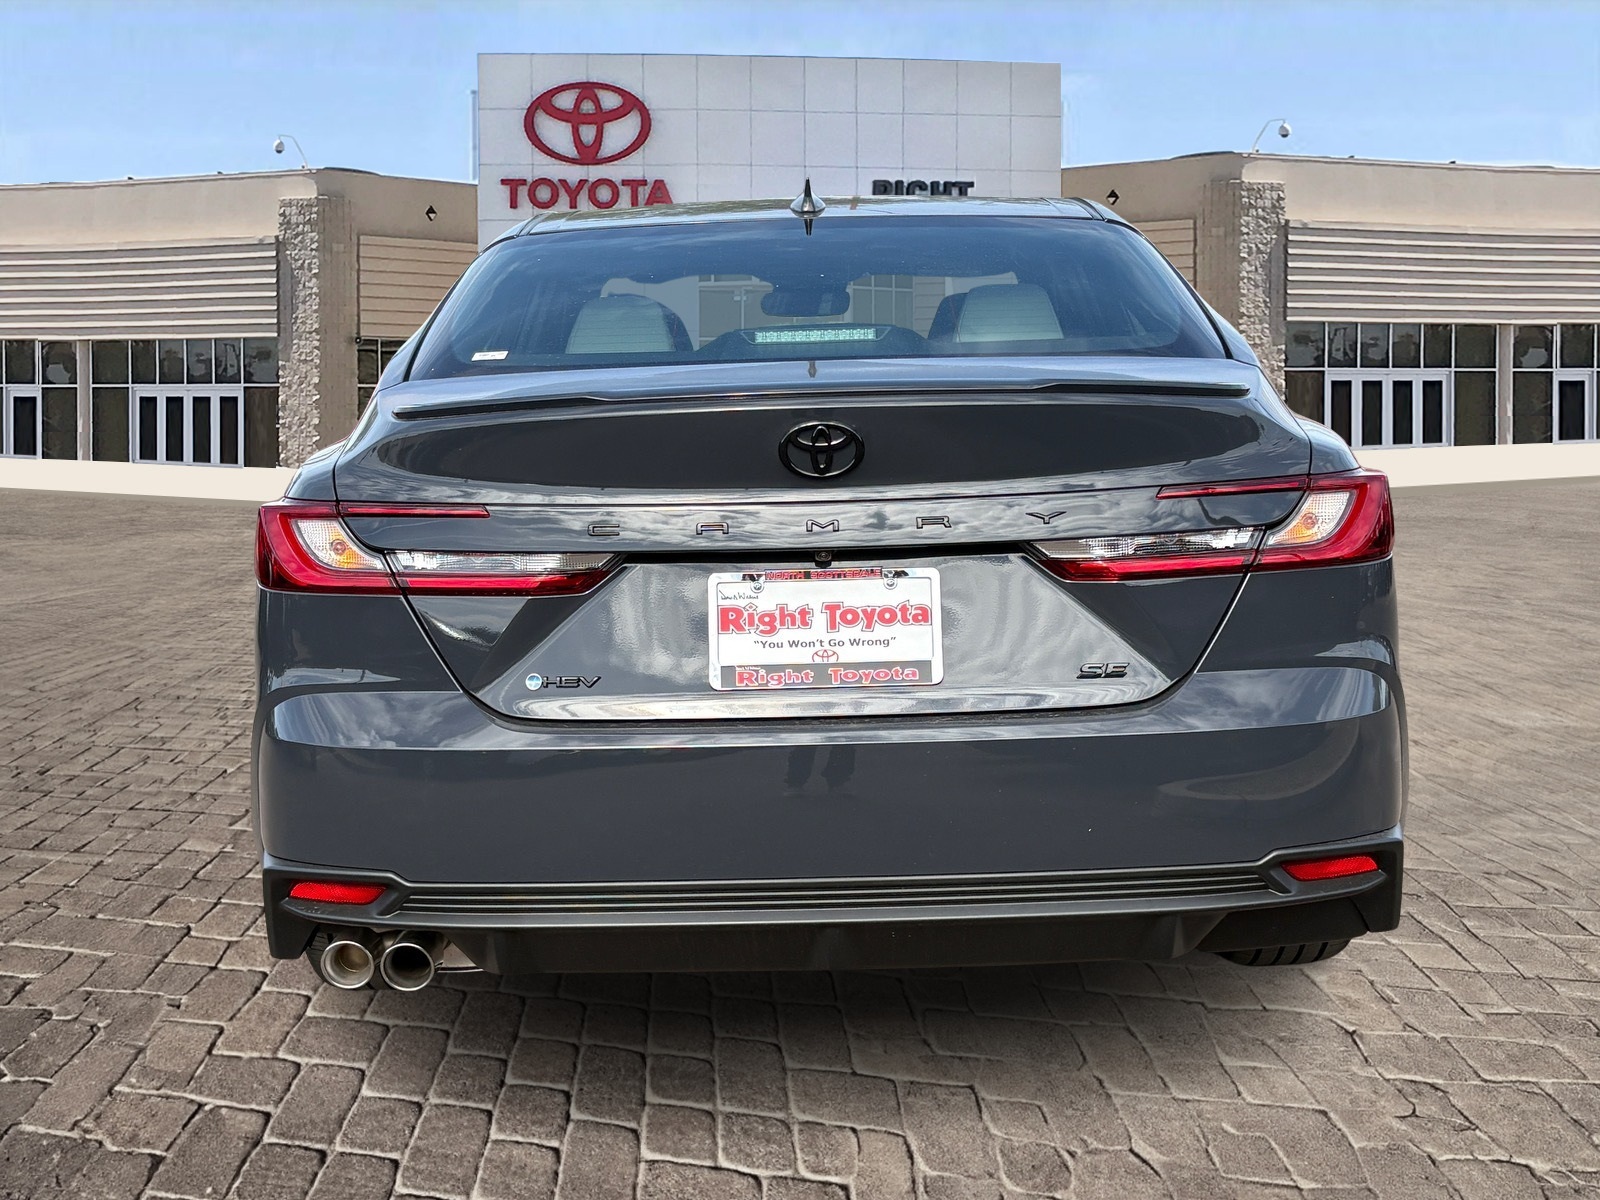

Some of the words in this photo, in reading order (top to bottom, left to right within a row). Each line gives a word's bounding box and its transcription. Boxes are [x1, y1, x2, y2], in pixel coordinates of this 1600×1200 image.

[500, 178, 674, 209] TOYOTA
[587, 510, 1067, 537] CAMRY
[766, 571, 804, 580] NORTH
[718, 602, 813, 637] Right
[822, 600, 932, 633] Toyota
[828, 638, 845, 647] Go
[736, 669, 814, 687] Right
[828, 667, 919, 685] Toyota
[1077, 663, 1130, 678] SE
[542, 676, 601, 688] HEV
